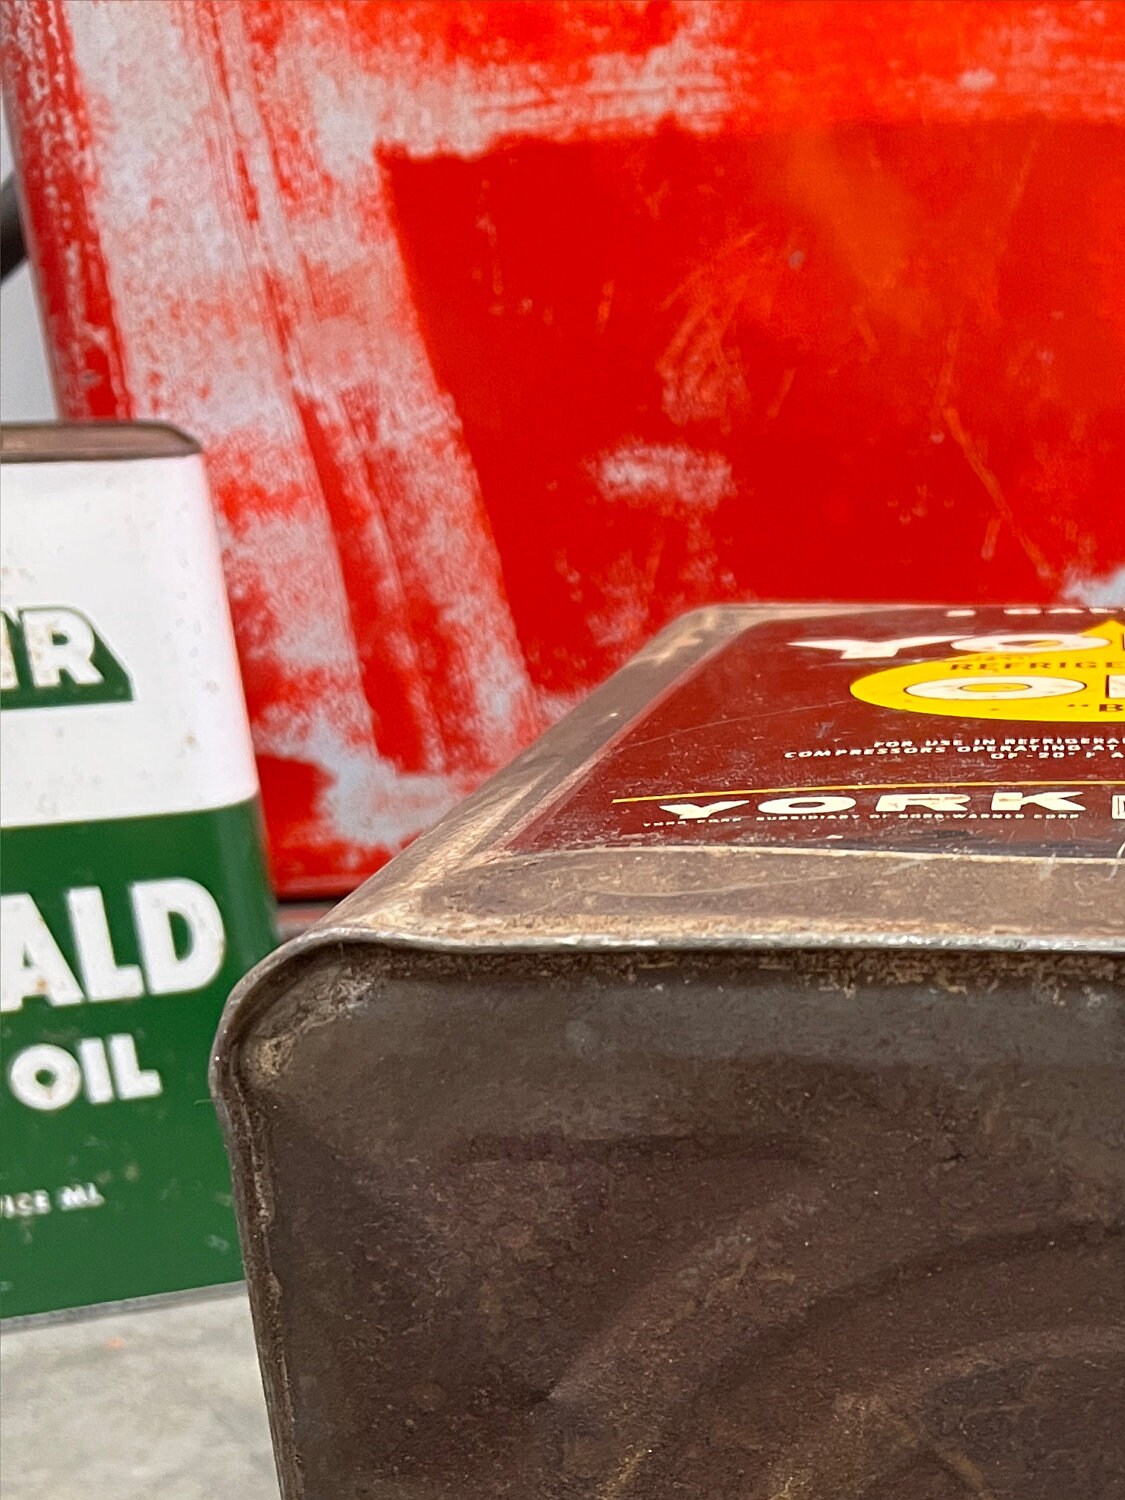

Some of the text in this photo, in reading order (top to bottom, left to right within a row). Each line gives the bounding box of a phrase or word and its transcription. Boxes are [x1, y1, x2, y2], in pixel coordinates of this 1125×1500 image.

[784, 747, 946, 759] COMPRESSORS
[957, 744, 1081, 753] OPERATING
[873, 740, 913, 748] FOR
[925, 739, 963, 747] USE
[974, 738, 996, 746] IN
[990, 752, 1017, 760] OF
[659, 791, 1086, 819] YORK
[0, 877, 225, 1012] ALD
[8, 1033, 163, 1111] OIL
[0, 1182, 106, 1219] ICE ML
